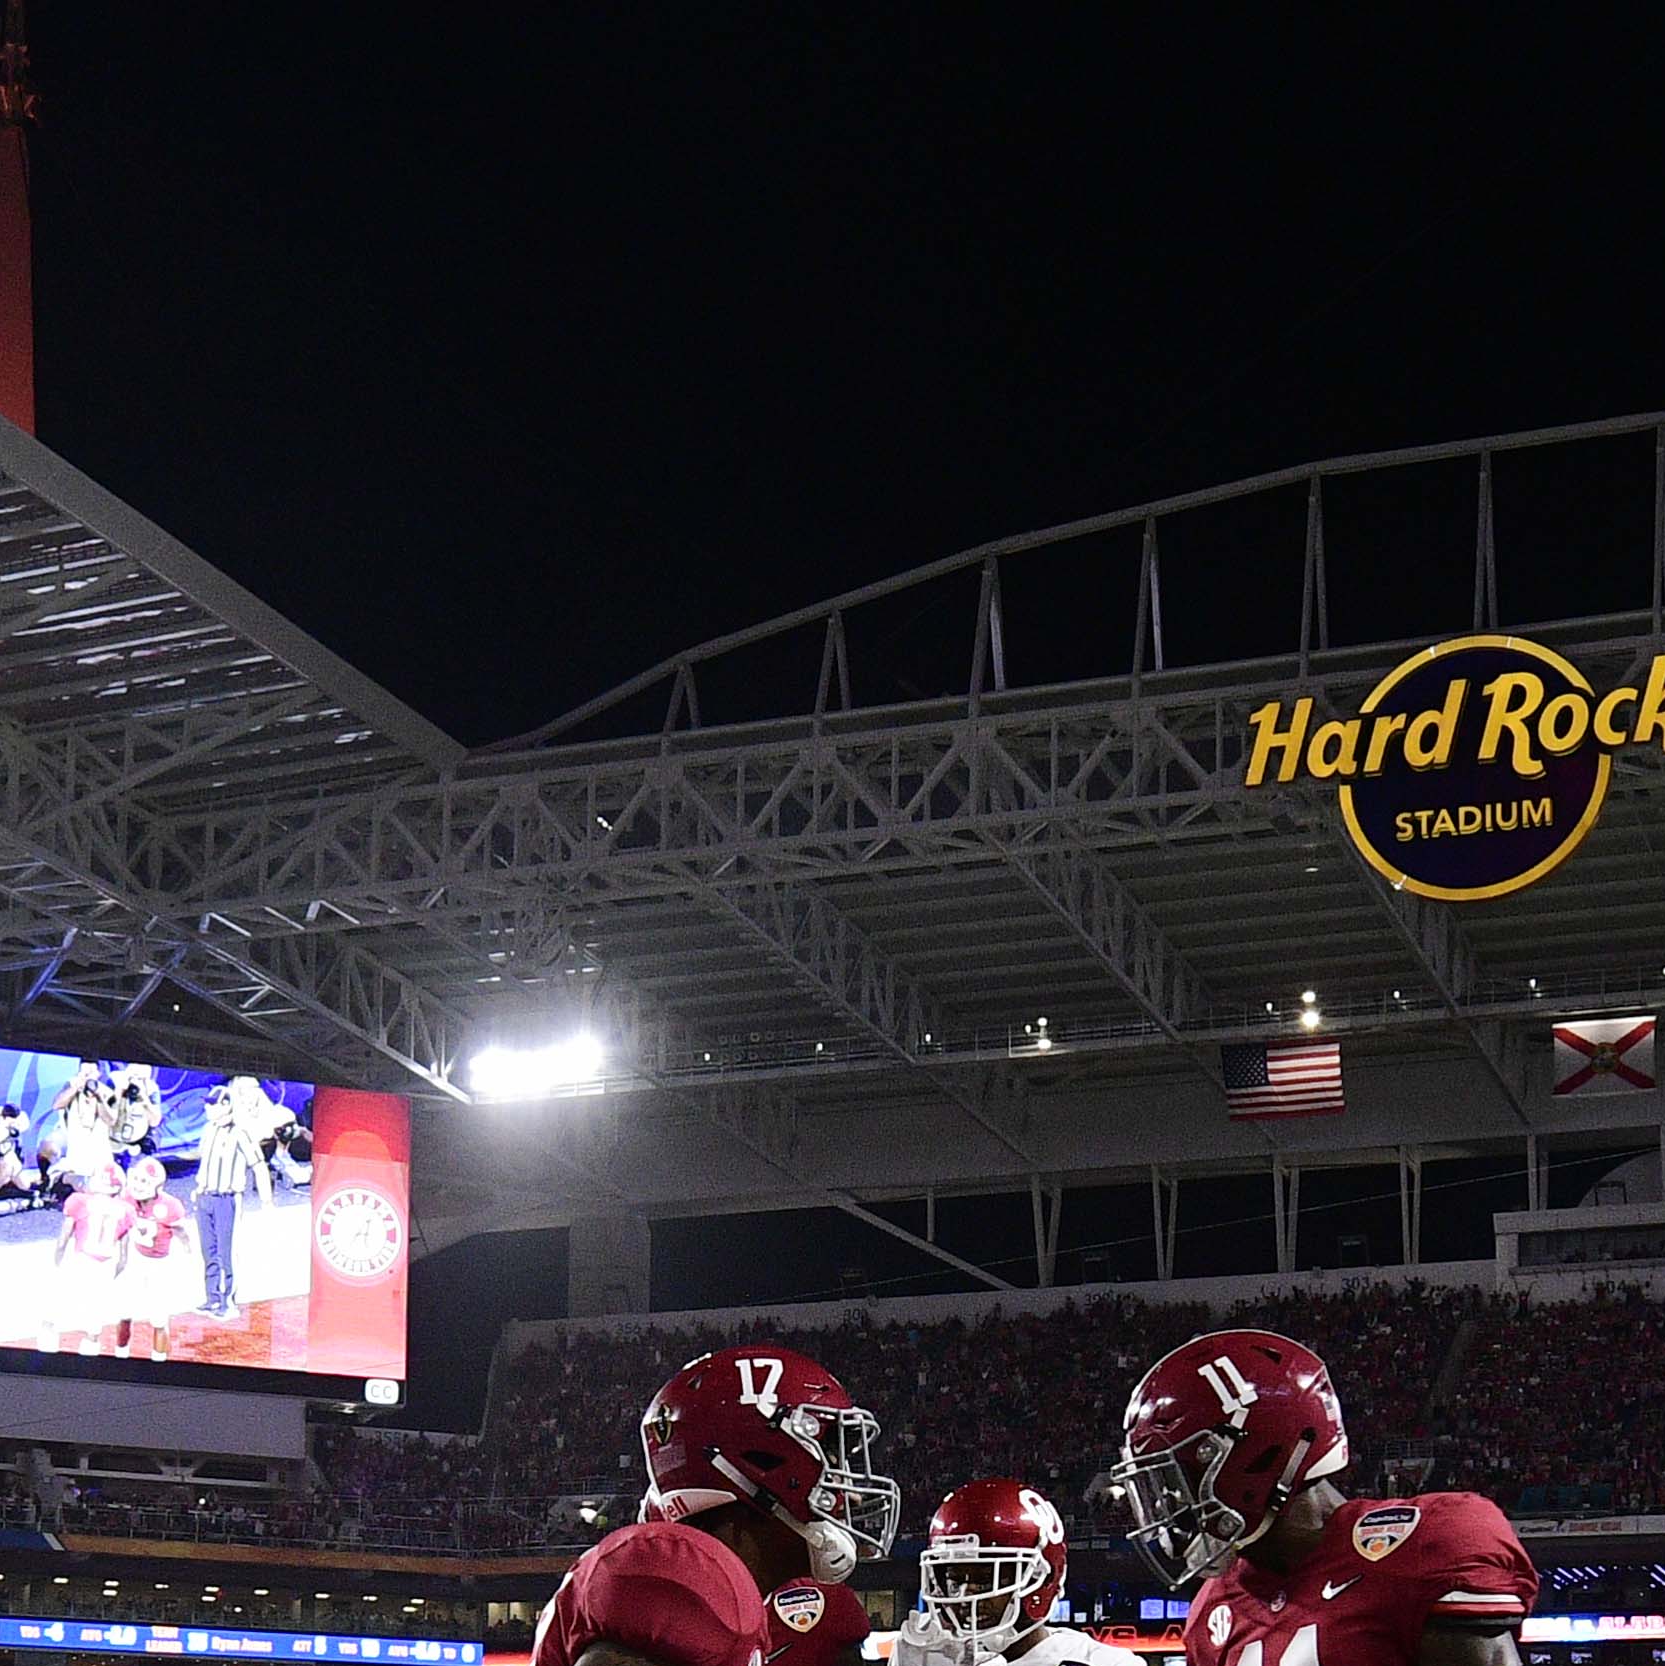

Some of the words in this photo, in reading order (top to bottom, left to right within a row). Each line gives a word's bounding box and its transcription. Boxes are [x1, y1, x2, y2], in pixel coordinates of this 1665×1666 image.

[1245, 678, 1470, 787] Hard
[1395, 797, 1555, 841] STADIUM
[735, 1358, 784, 1404] 17
[1198, 1356, 1258, 1414] 11
